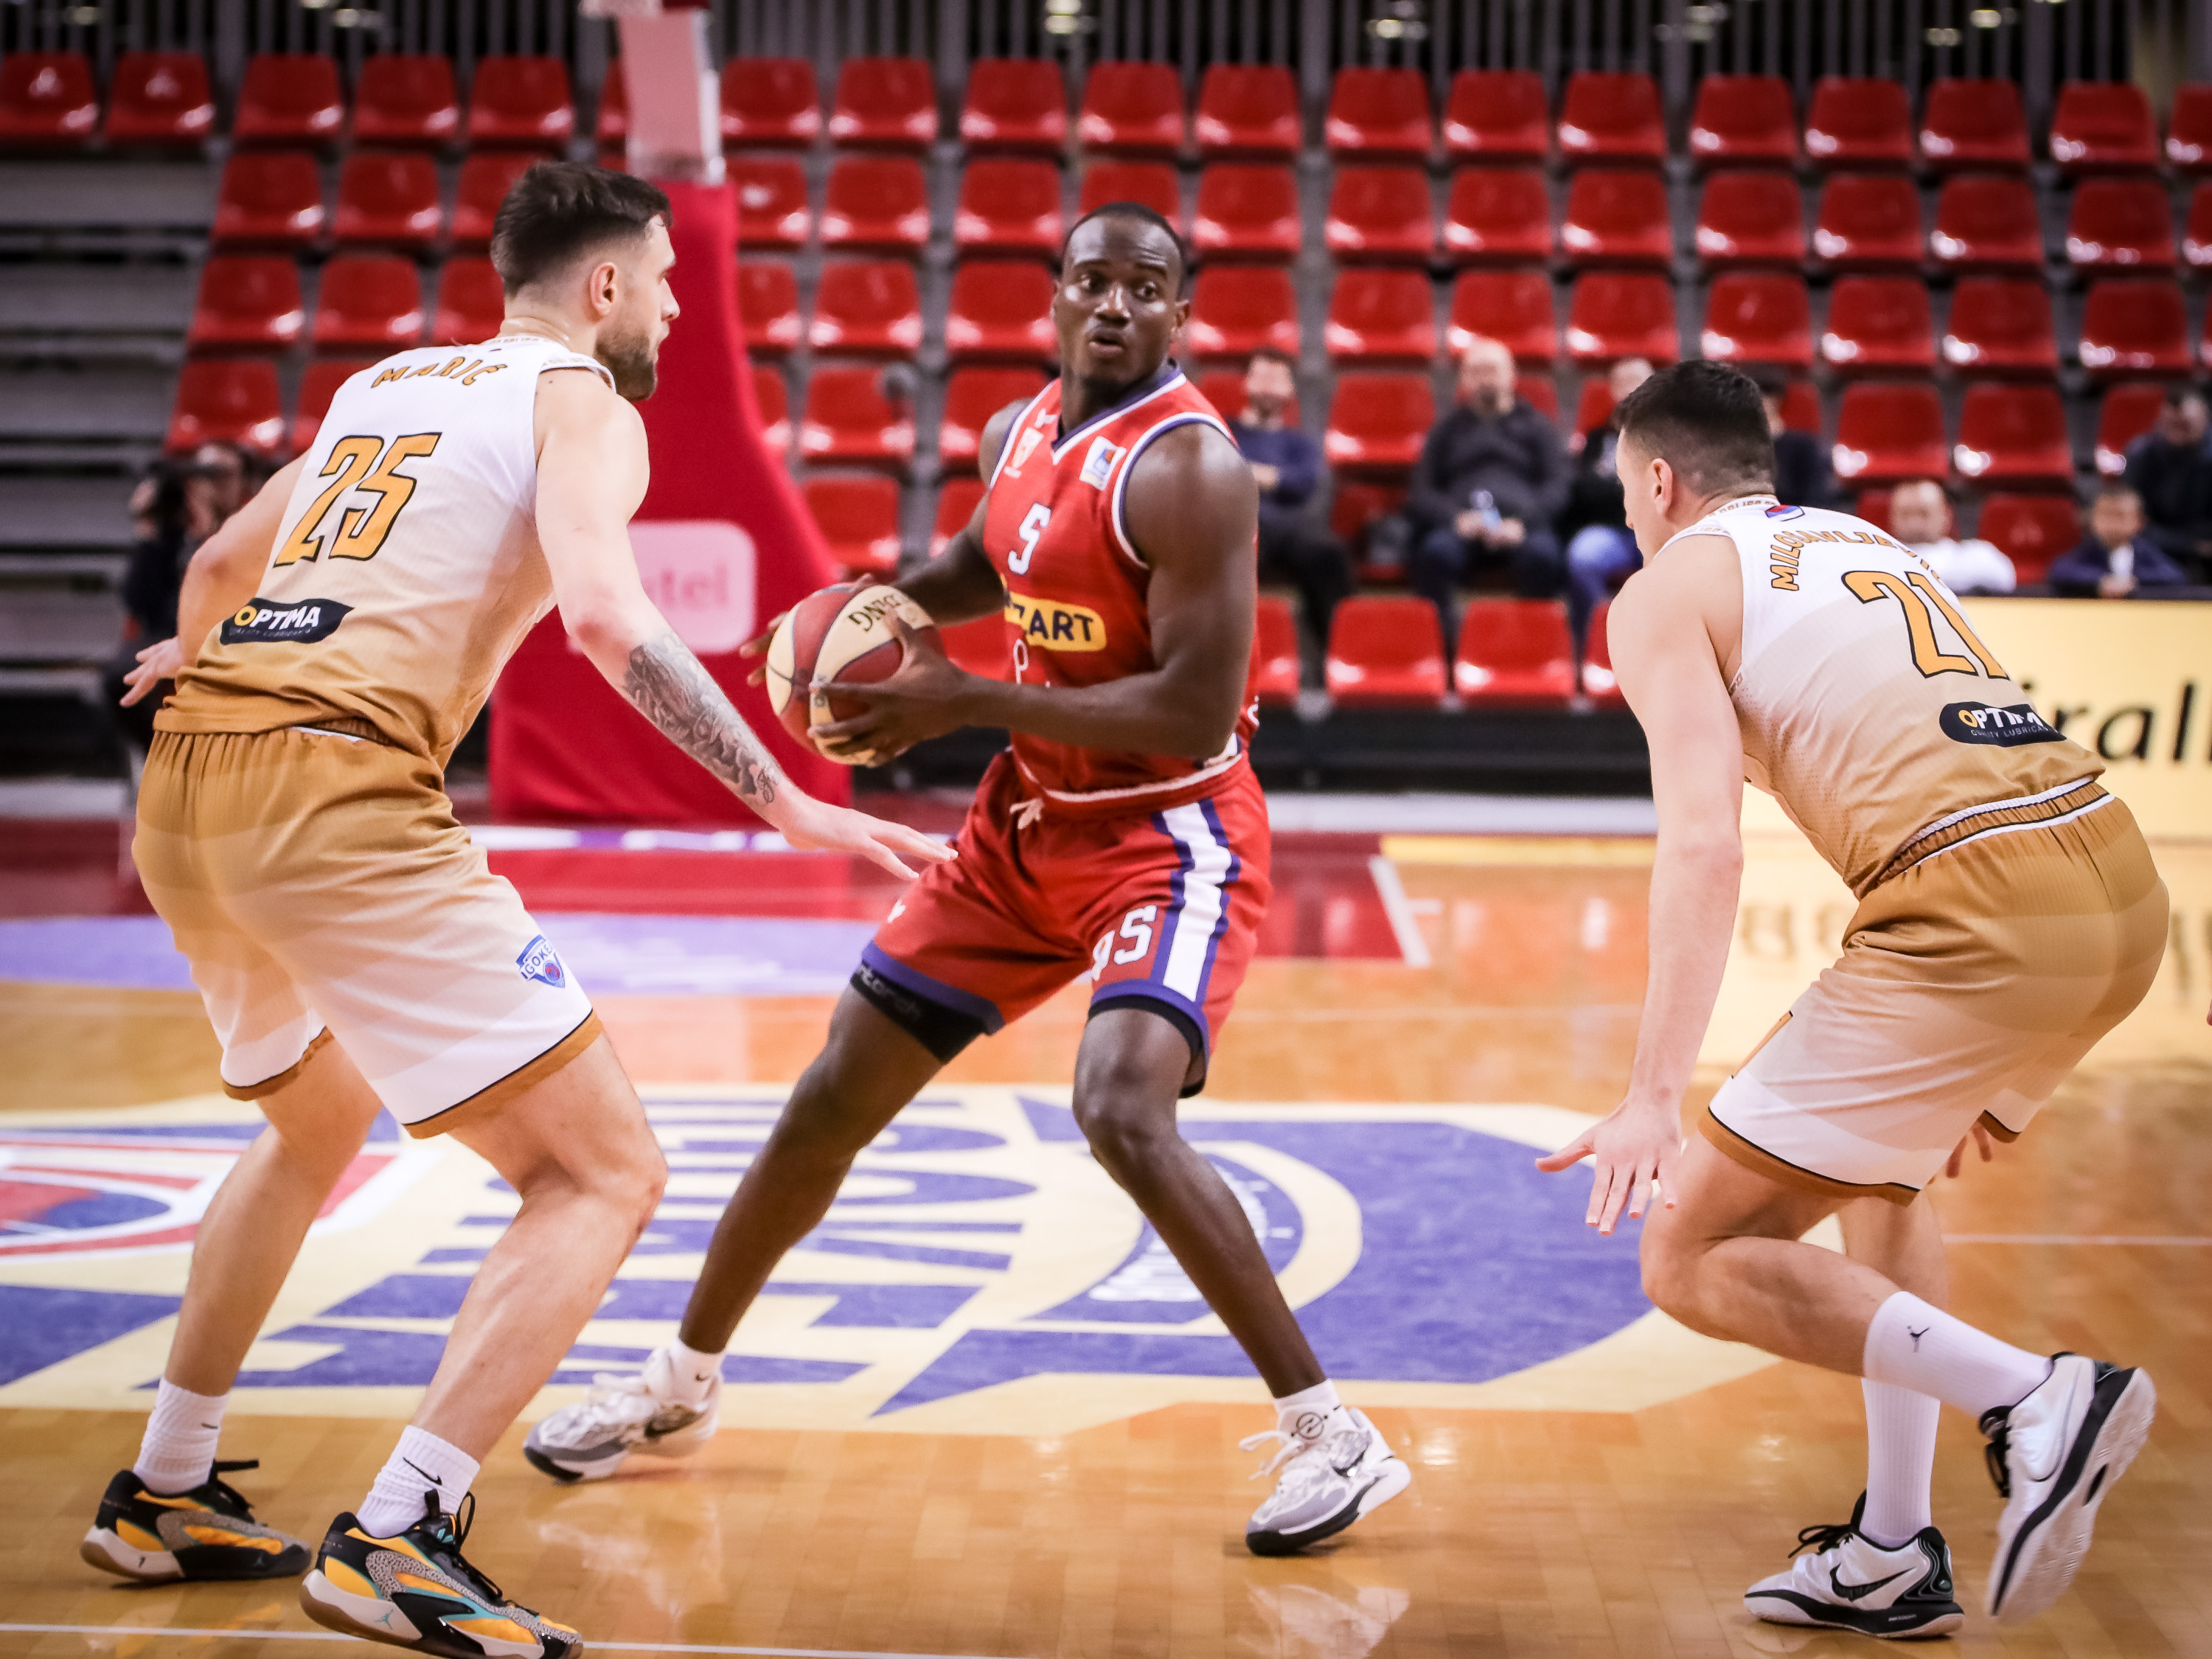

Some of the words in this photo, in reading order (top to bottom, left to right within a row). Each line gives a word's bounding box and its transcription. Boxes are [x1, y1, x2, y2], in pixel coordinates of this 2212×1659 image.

[274, 432, 442, 568] 25
[234, 605, 321, 630] OPTIMA
[1842, 570, 2011, 680] 21
[521, 943, 553, 979] IGOKE
